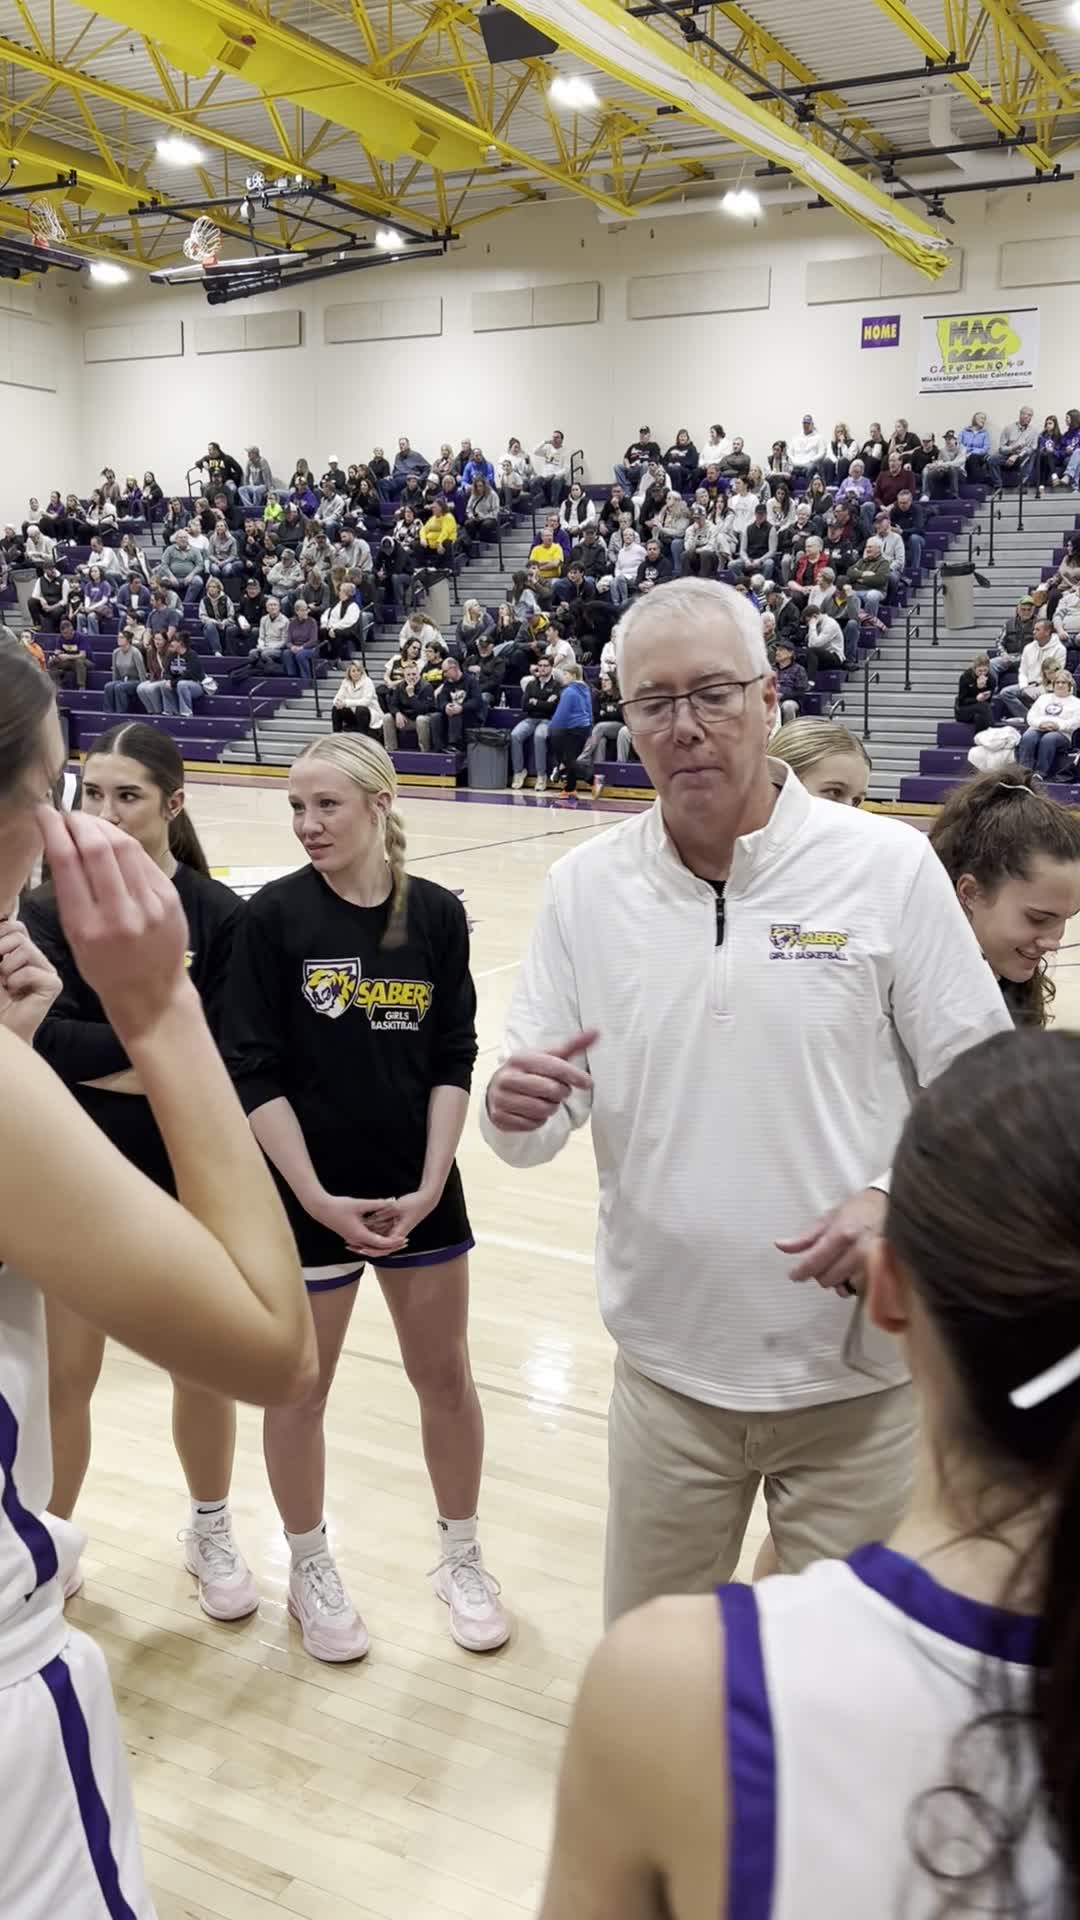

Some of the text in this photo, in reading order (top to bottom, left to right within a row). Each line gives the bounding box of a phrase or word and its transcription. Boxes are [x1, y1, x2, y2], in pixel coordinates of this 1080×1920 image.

[864, 323, 897, 340] HOME
[949, 317, 1008, 346] MAC
[921, 374, 960, 382] Mississippi
[991, 370, 1033, 378] Conference
[798, 931, 849, 951] SABERS
[770, 951, 849, 961] GIRLS BASKETBALL
[385, 1011, 409, 1020] GIRLS
